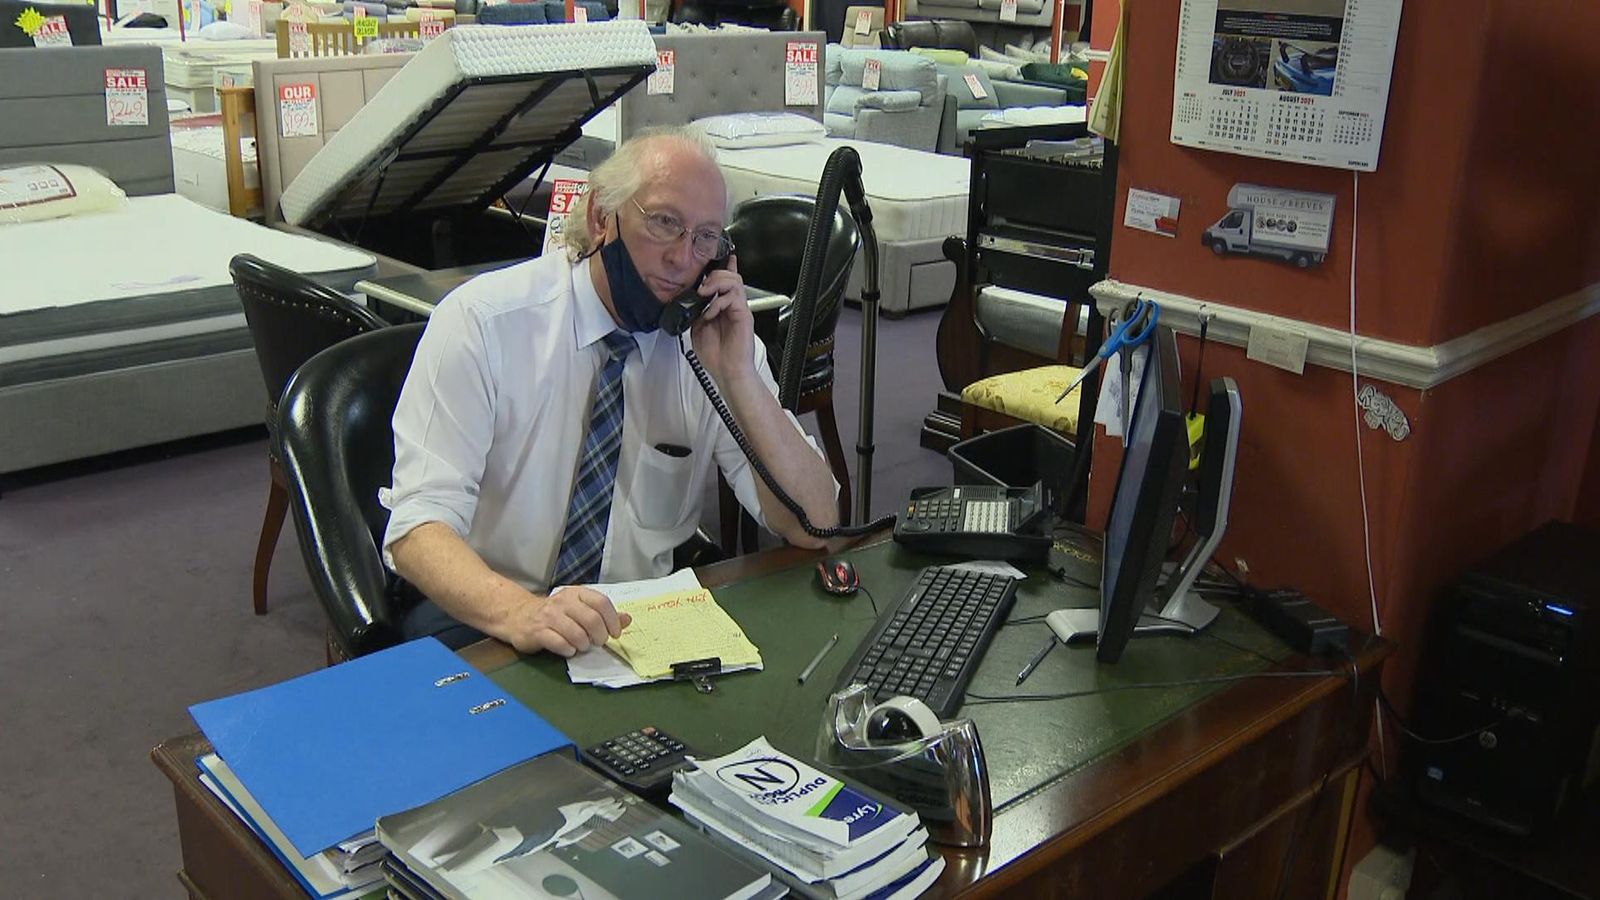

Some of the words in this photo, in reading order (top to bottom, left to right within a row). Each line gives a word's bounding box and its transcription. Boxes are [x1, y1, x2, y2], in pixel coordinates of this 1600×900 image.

[786, 50, 817, 62] SALE
[106, 77, 146, 88] SALE
[284, 86, 312, 99] OUR
[1279, 94, 1300, 103] AUGUST
[1300, 96, 1314, 105] 2021
[1247, 194, 1277, 205] HOUSE
[1288, 200, 1323, 210] REEVES
[734, 767, 786, 791] N
